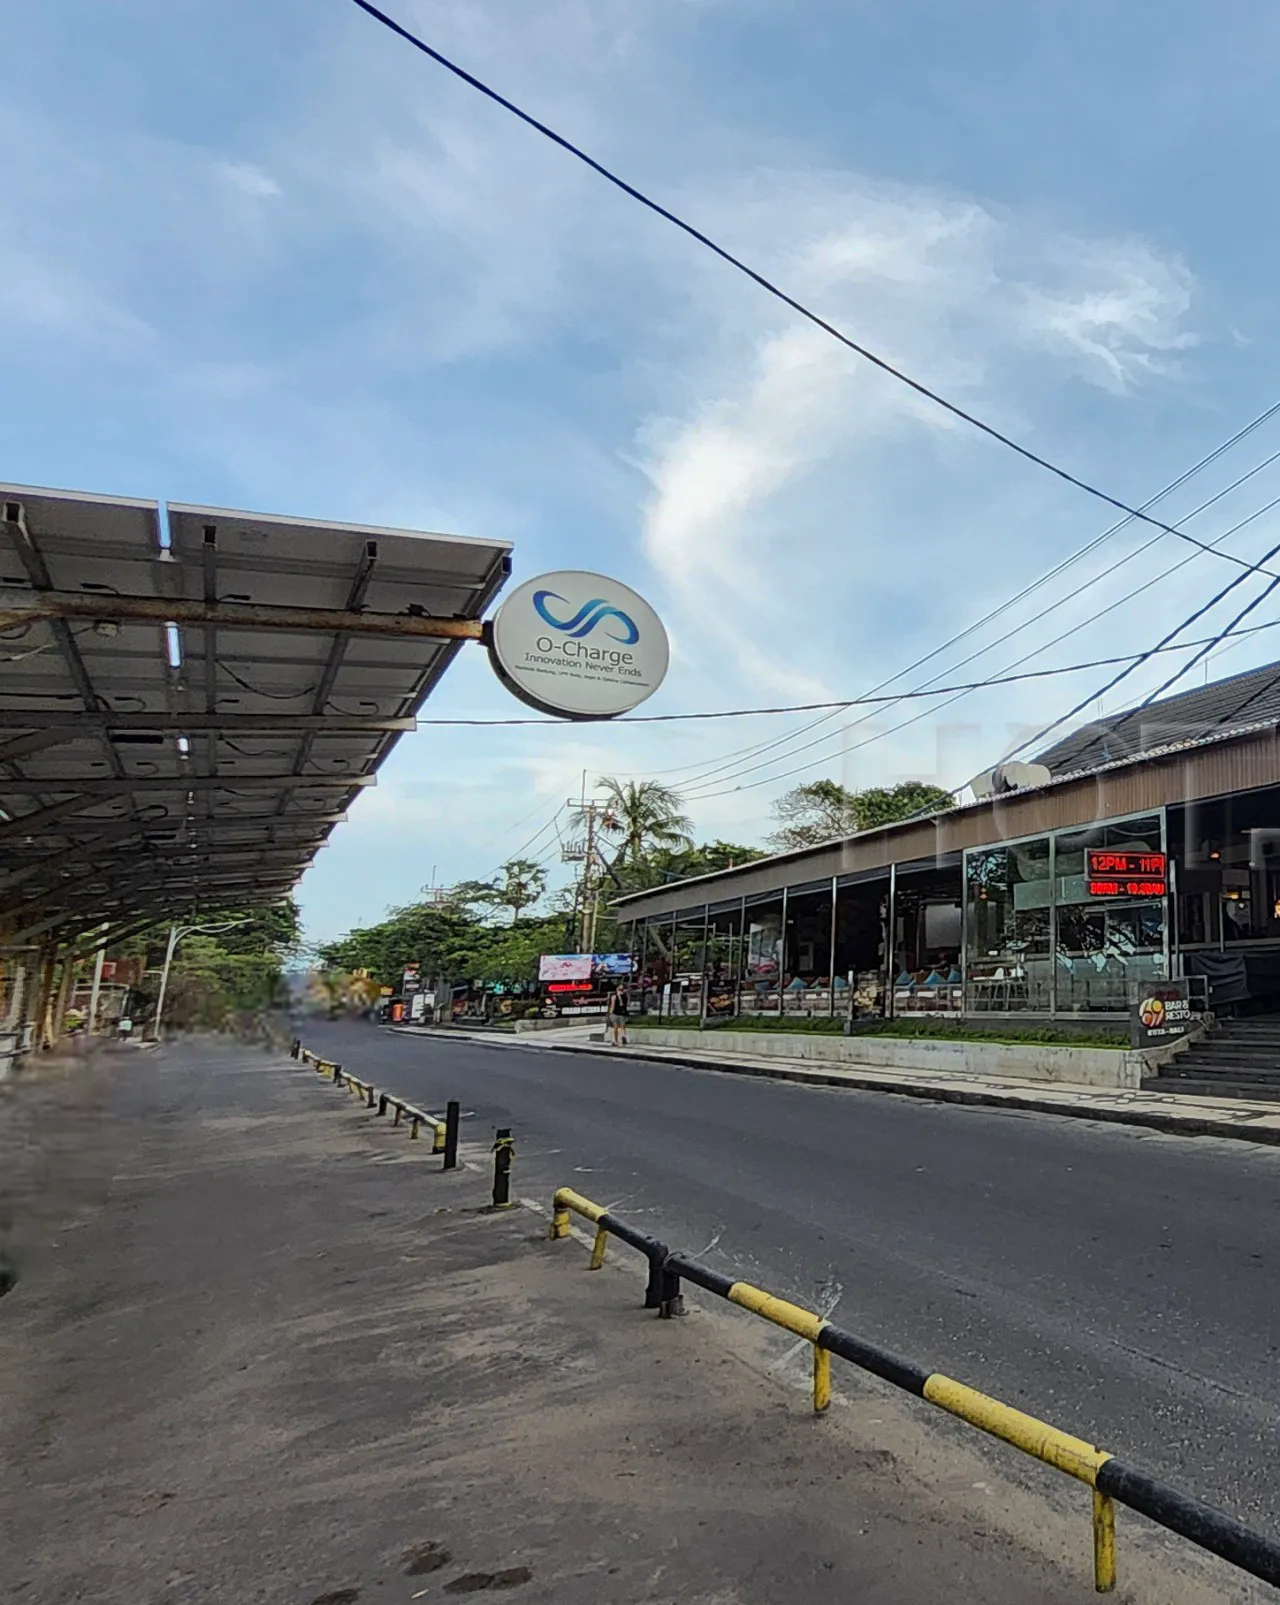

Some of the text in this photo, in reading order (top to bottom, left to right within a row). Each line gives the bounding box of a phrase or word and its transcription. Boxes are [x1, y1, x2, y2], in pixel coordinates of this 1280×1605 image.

[536, 636, 633, 667] O-Charge
[524, 652, 582, 670] Innovation
[585, 661, 614, 674] Never
[618, 666, 642, 678] Ends
[1092, 856, 1126, 870] 12PM
[1165, 1001, 1182, 1010] BAR
[1166, 1010, 1190, 1020] RESTO
